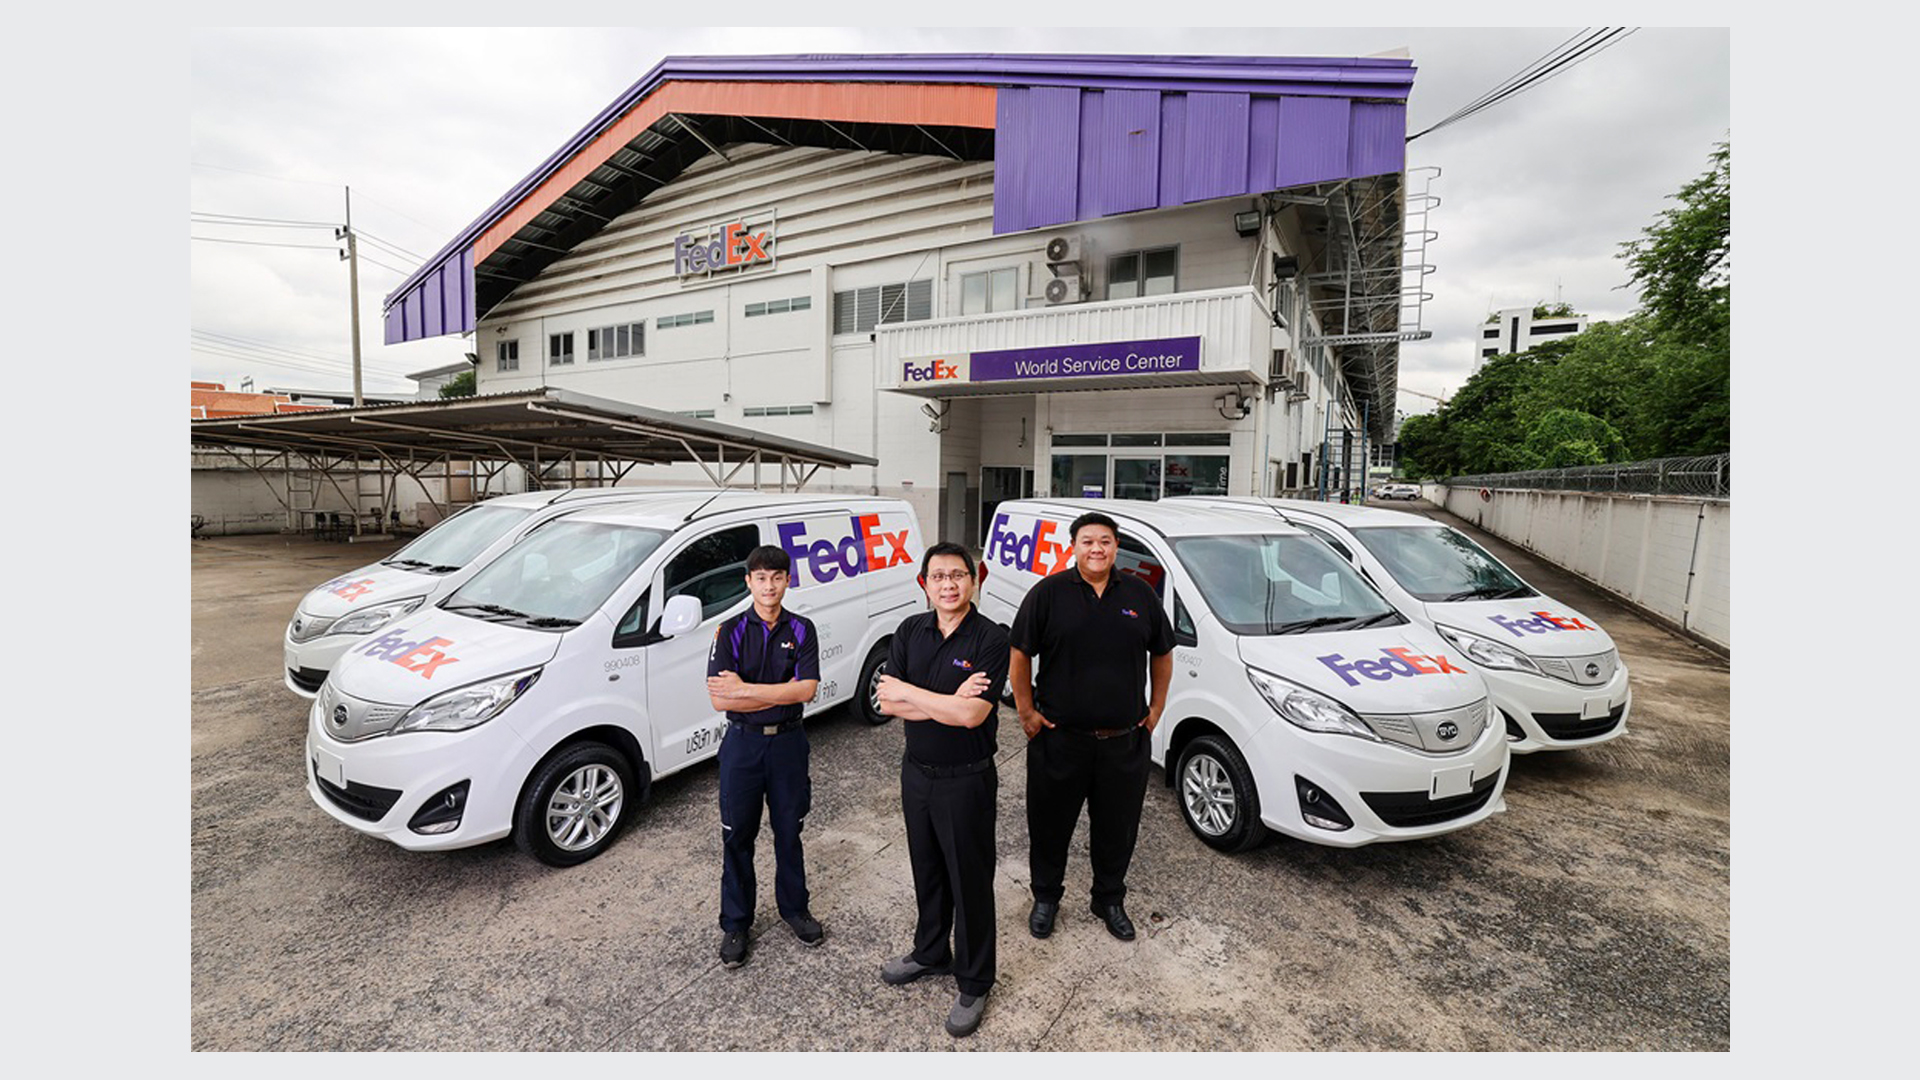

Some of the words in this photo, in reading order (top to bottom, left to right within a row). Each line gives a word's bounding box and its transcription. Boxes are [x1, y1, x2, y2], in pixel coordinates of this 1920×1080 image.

[674, 222, 769, 275] FedEx
[903, 359, 958, 382] FedEx
[1014, 359, 1058, 376] World
[1062, 355, 1121, 374] Service
[1125, 352, 1183, 370] Center
[777, 513, 914, 588] FedEx
[987, 512, 1074, 578] FedEx
[1487, 611, 1596, 637] FedEx
[353, 628, 460, 680] FedEx
[604, 654, 640, 672] 990408
[1316, 647, 1468, 687] FedEx
[686, 728, 711, 754] บริษัท
